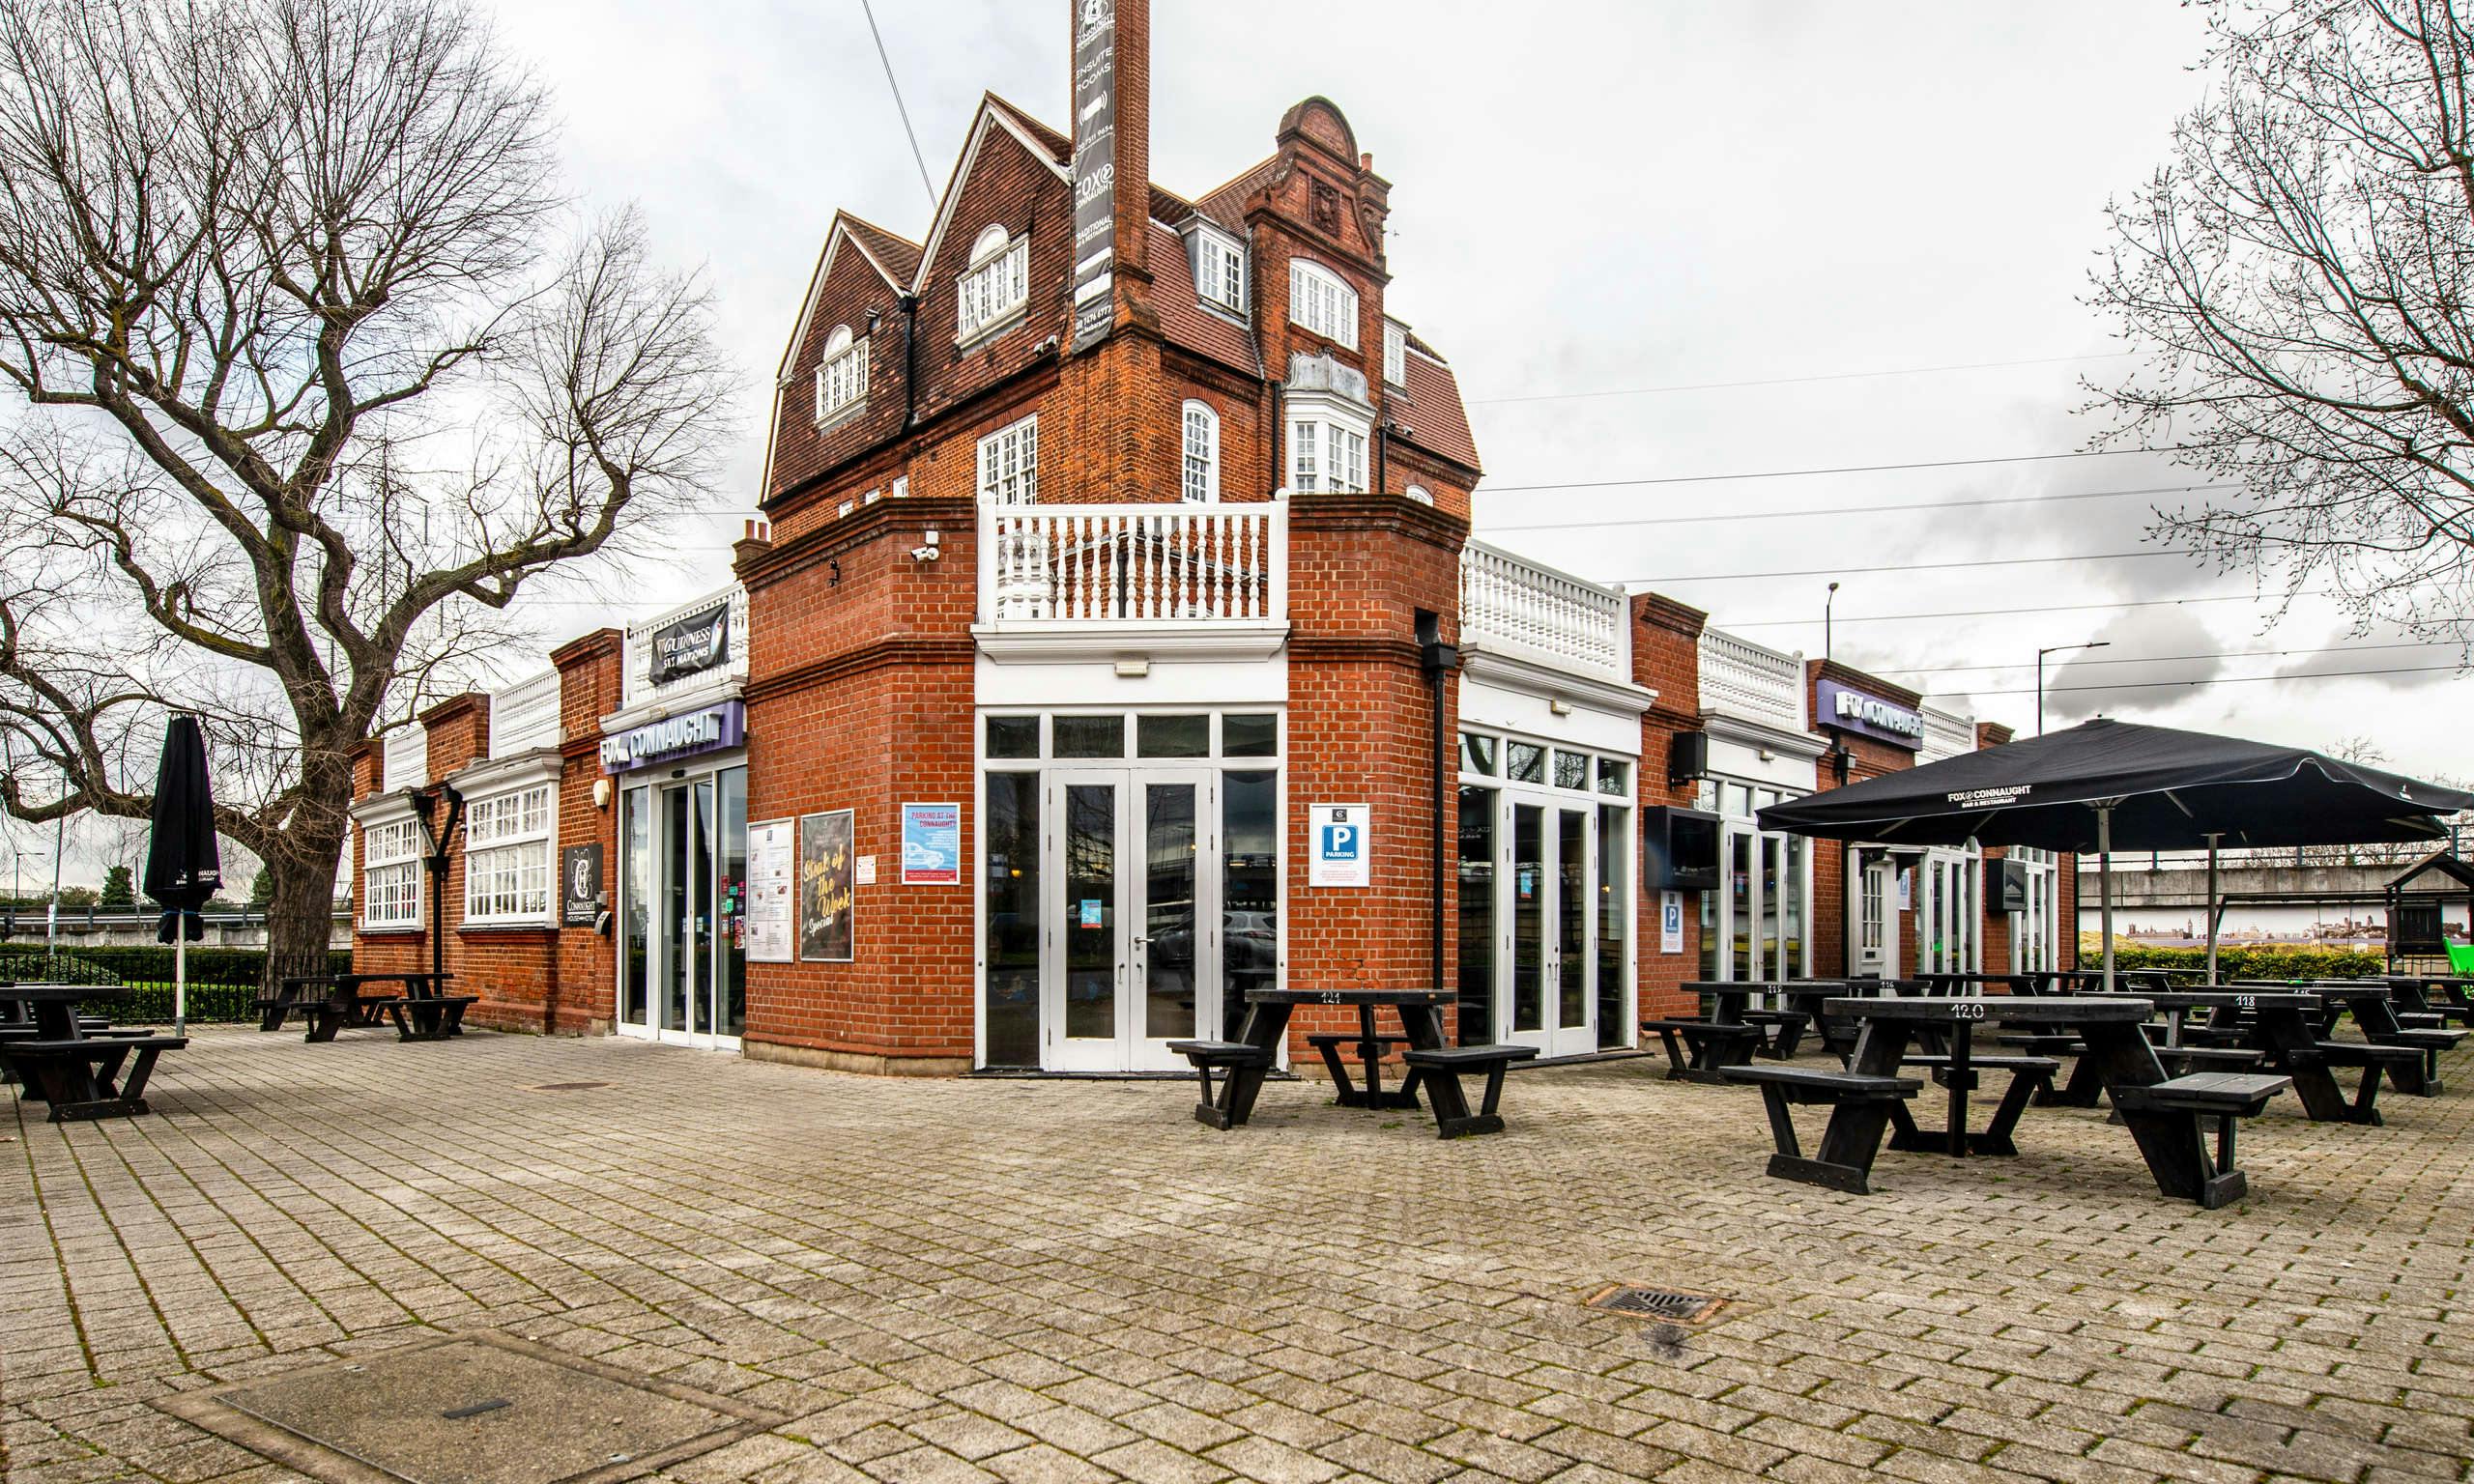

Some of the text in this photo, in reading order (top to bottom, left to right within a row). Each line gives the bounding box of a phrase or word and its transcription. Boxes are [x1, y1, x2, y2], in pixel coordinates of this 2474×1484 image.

[1077, 46, 1112, 78] ENSUITE
[1077, 62, 1111, 93] ROOMS
[664, 626, 711, 653] GUINNESS
[664, 645, 709, 670] SIX NATIONS
[600, 710, 723, 766] FOX CONNAUGHT
[1947, 785, 2031, 803] FOX CONNAUGHT
[1962, 800, 1973, 809] BAR
[1979, 796, 2017, 807] RESTAURANT
[1333, 826, 1351, 851] P
[803, 851, 830, 882] Steak
[832, 843, 846, 870] of
[818, 873, 836, 898] the
[818, 887, 851, 918] Week
[809, 913, 834, 938] Special
[1321, 990, 1340, 1004] 121
[2235, 994, 2256, 1007] 118
[1951, 1004, 1984, 1019] 120
